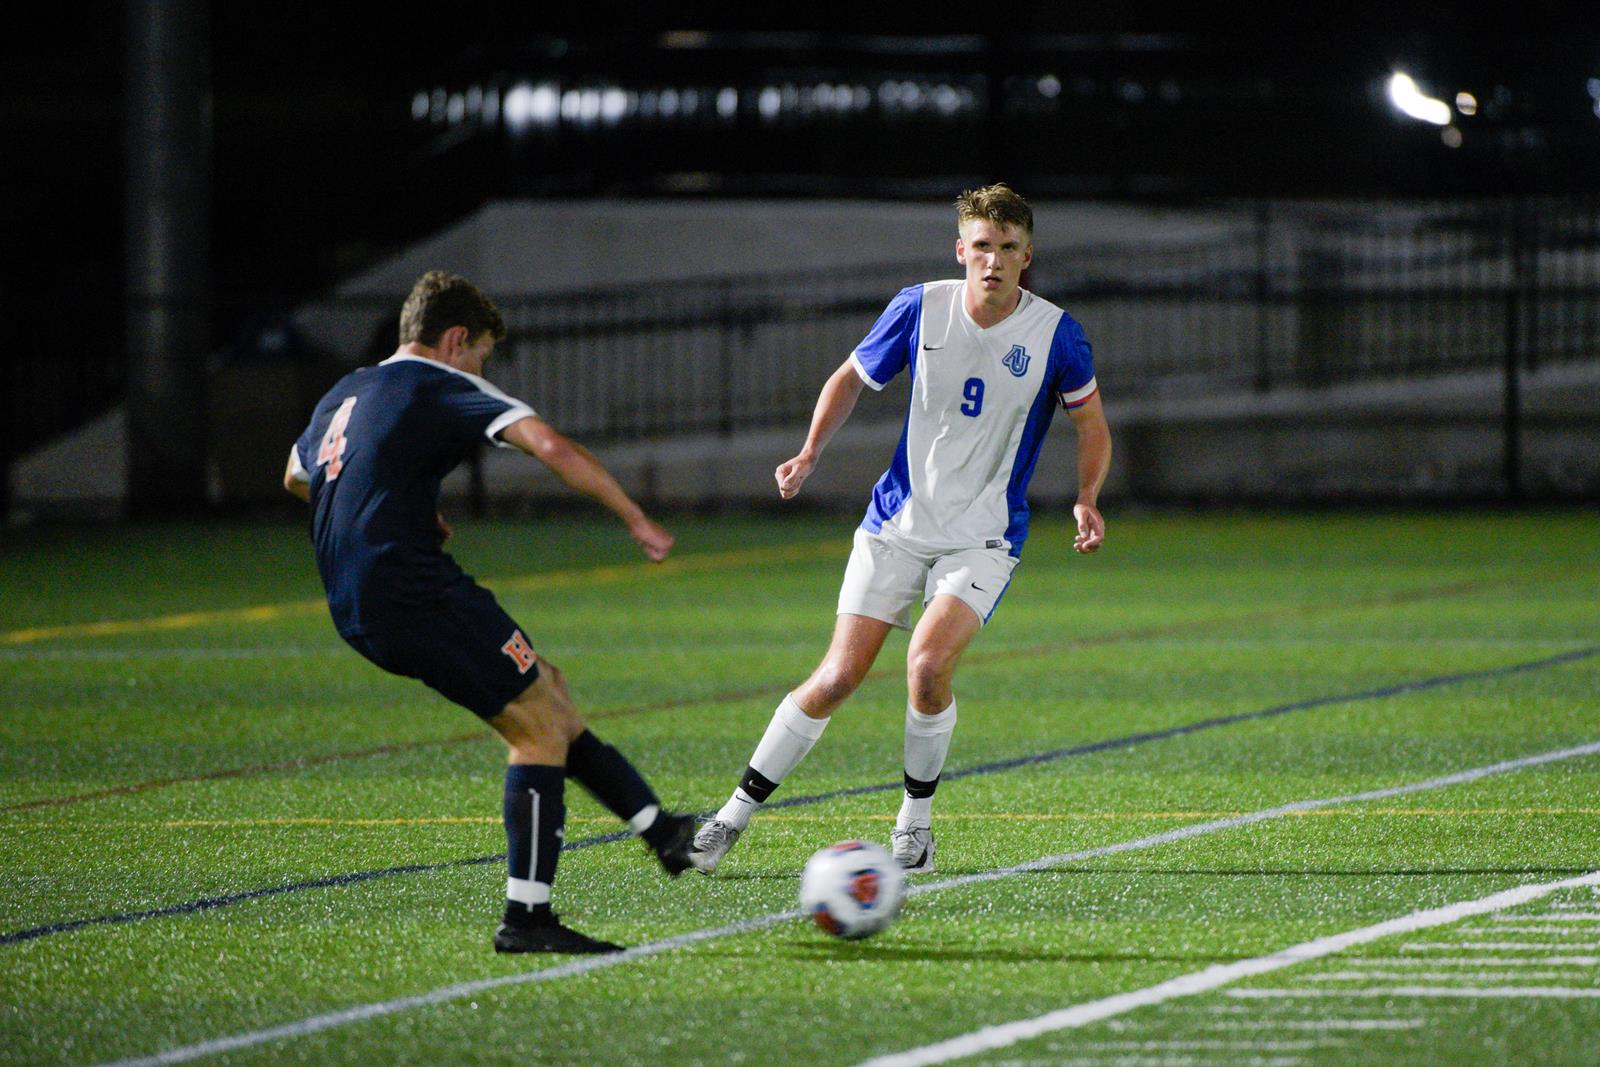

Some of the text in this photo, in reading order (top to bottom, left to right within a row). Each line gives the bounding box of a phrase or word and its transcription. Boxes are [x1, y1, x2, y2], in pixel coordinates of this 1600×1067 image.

[960, 377, 985, 417] 9
[316, 396, 357, 482] 4
[501, 629, 536, 674] H
